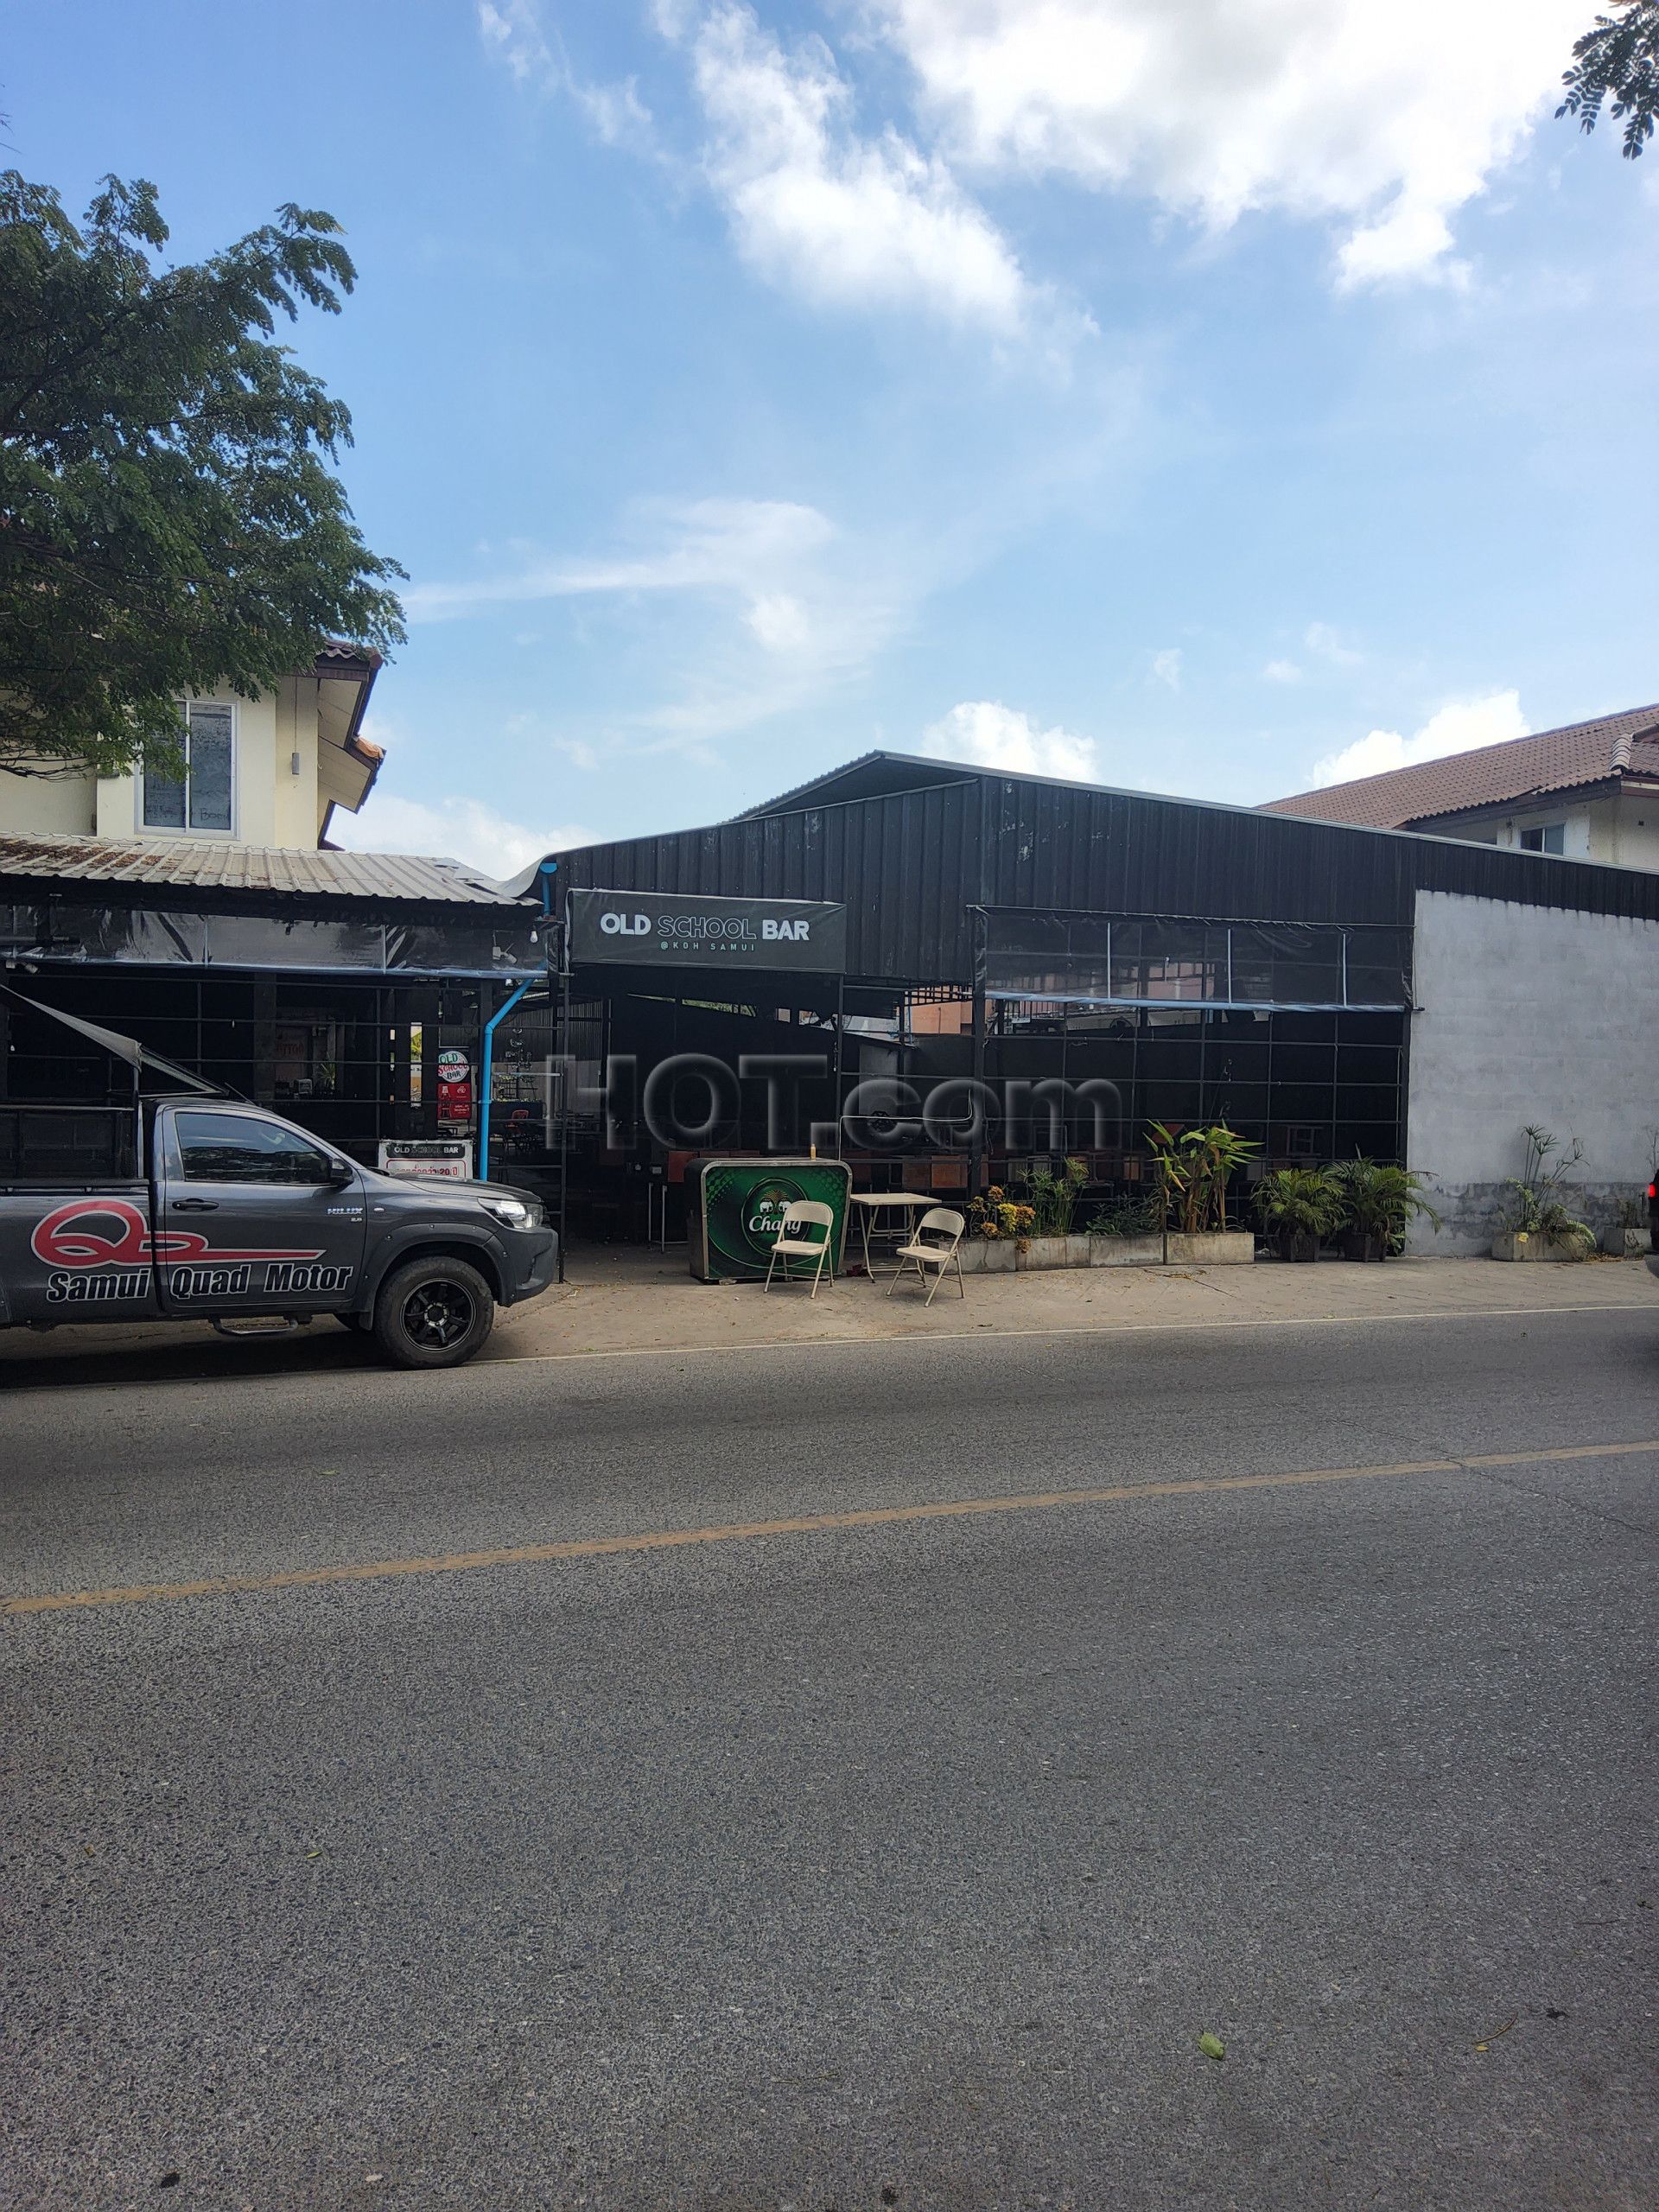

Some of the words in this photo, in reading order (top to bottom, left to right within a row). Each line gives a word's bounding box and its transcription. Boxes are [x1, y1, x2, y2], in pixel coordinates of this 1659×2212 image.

[601, 912, 652, 935] OLD
[658, 915, 757, 939] SCHOOL
[762, 919, 810, 941] BAR
[710, 943, 755, 951] SAMUI
[439, 1052, 459, 1065] OLD
[447, 1071, 461, 1080] BAR
[46, 1269, 151, 1303] Samui
[170, 1264, 251, 1300] Quad
[264, 1263, 353, 1294] Motor
